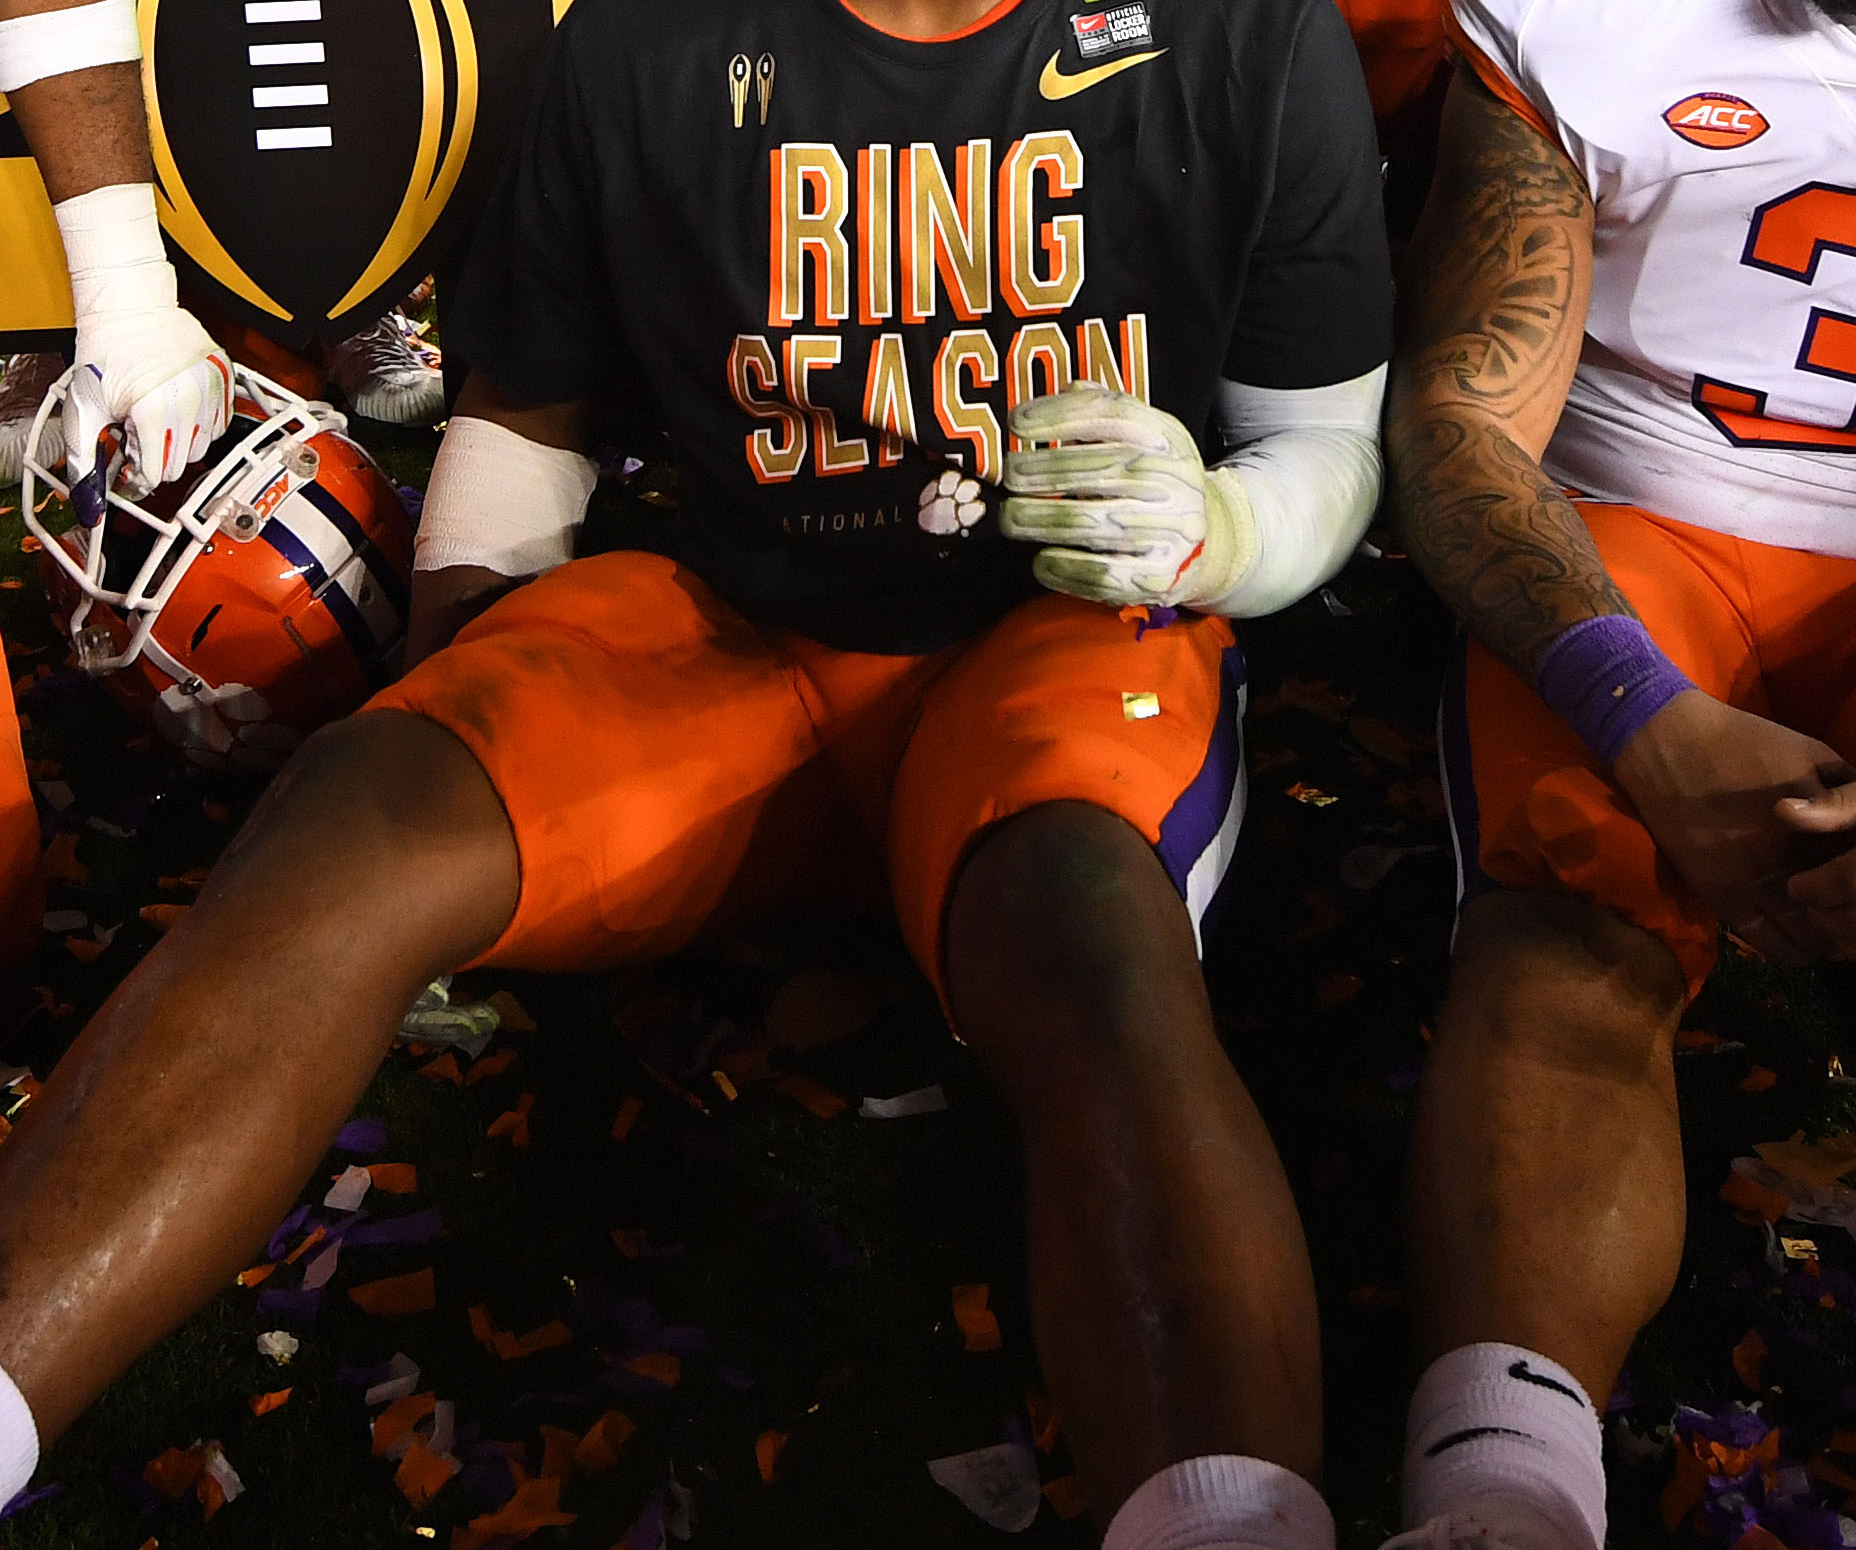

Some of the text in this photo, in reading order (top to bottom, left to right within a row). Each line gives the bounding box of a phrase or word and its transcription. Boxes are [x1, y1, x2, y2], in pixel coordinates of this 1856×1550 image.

[1110, 24, 1149, 43] ROOM
[1675, 101, 1758, 132] ACC
[768, 128, 1085, 327] RING
